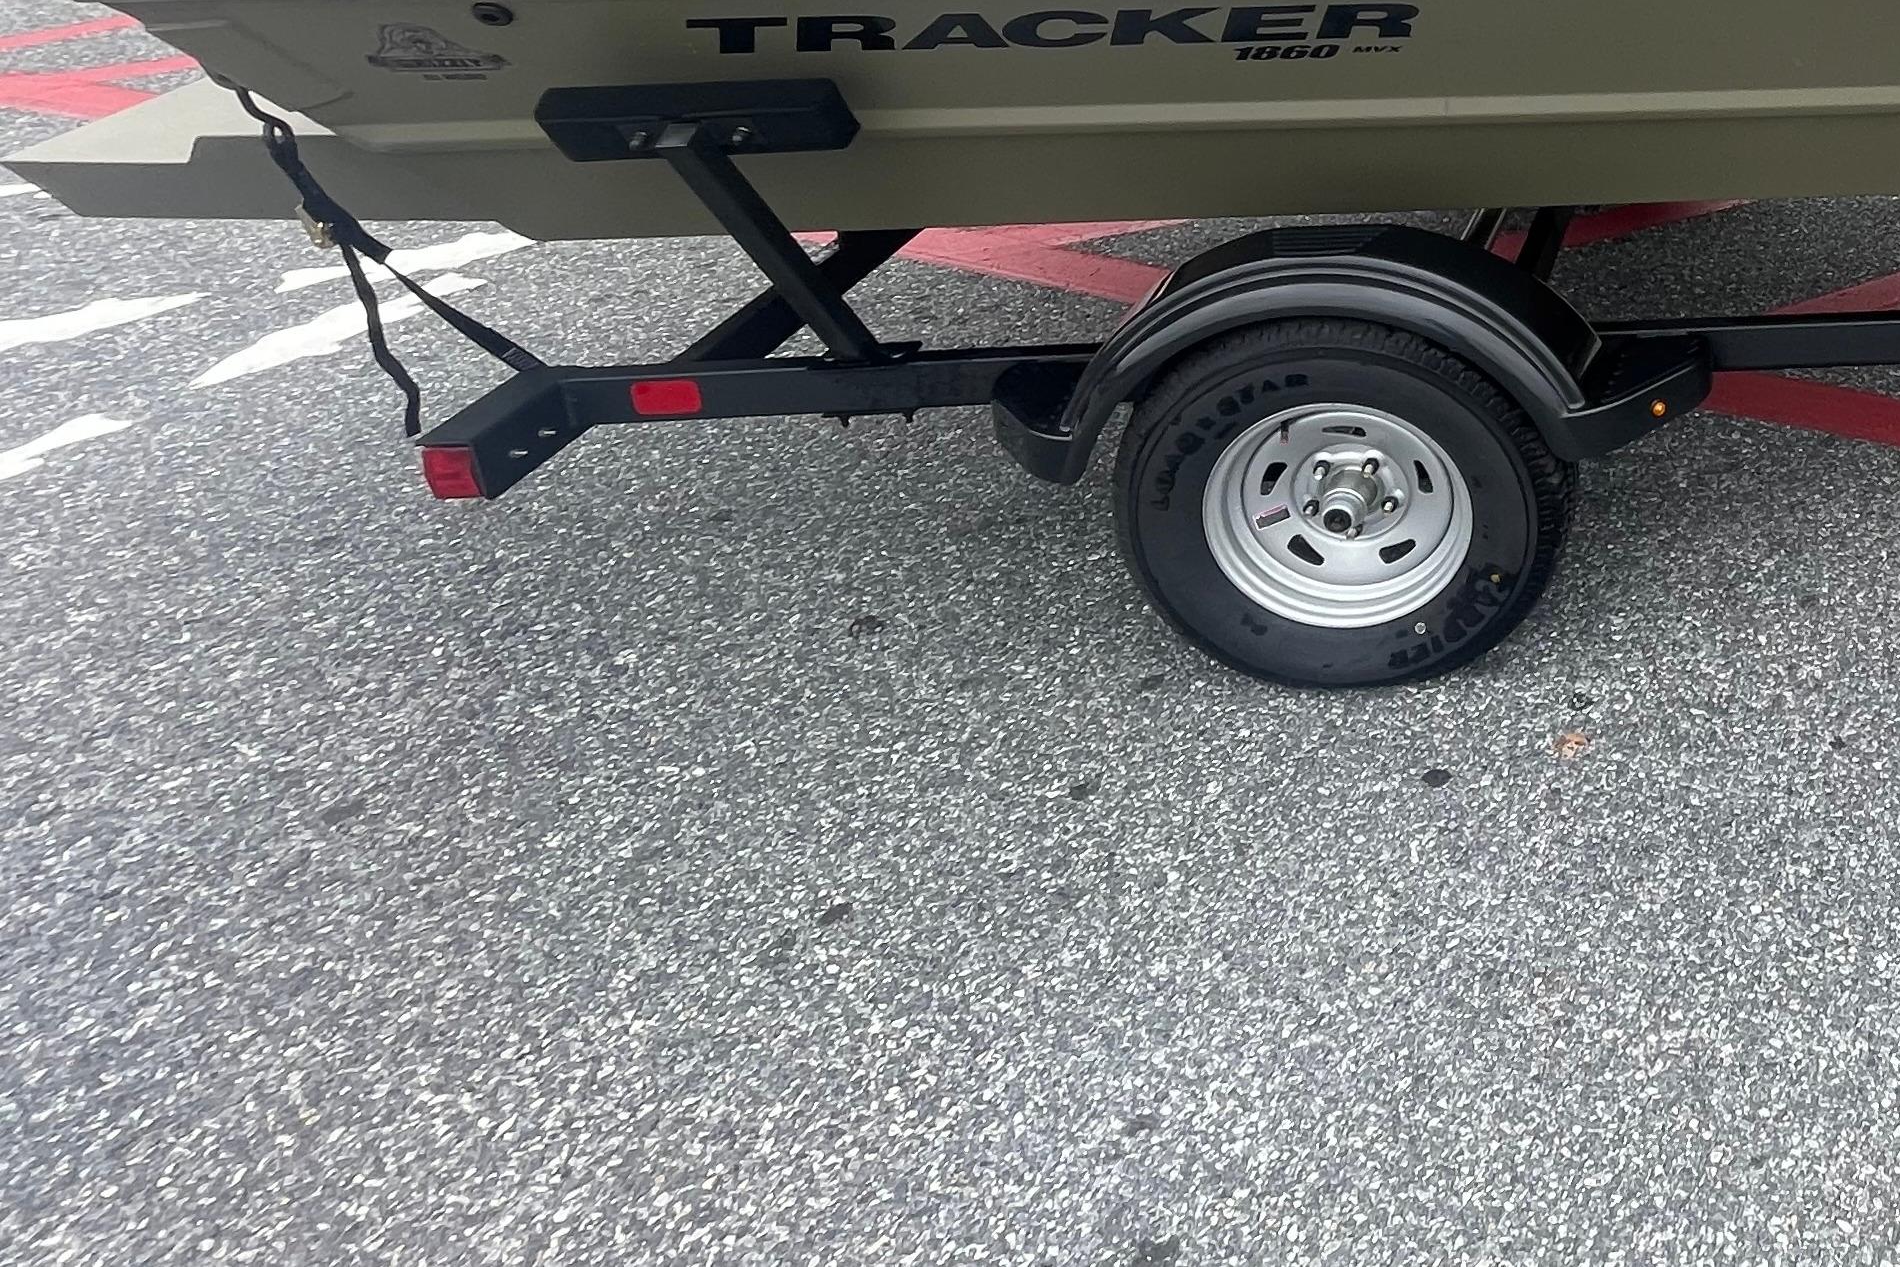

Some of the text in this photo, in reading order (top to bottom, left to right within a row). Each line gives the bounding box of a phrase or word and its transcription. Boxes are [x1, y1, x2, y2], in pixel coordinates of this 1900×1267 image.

[686, 3, 1419, 54] TRACKER
[1234, 44, 1402, 61] 1860 MVX
